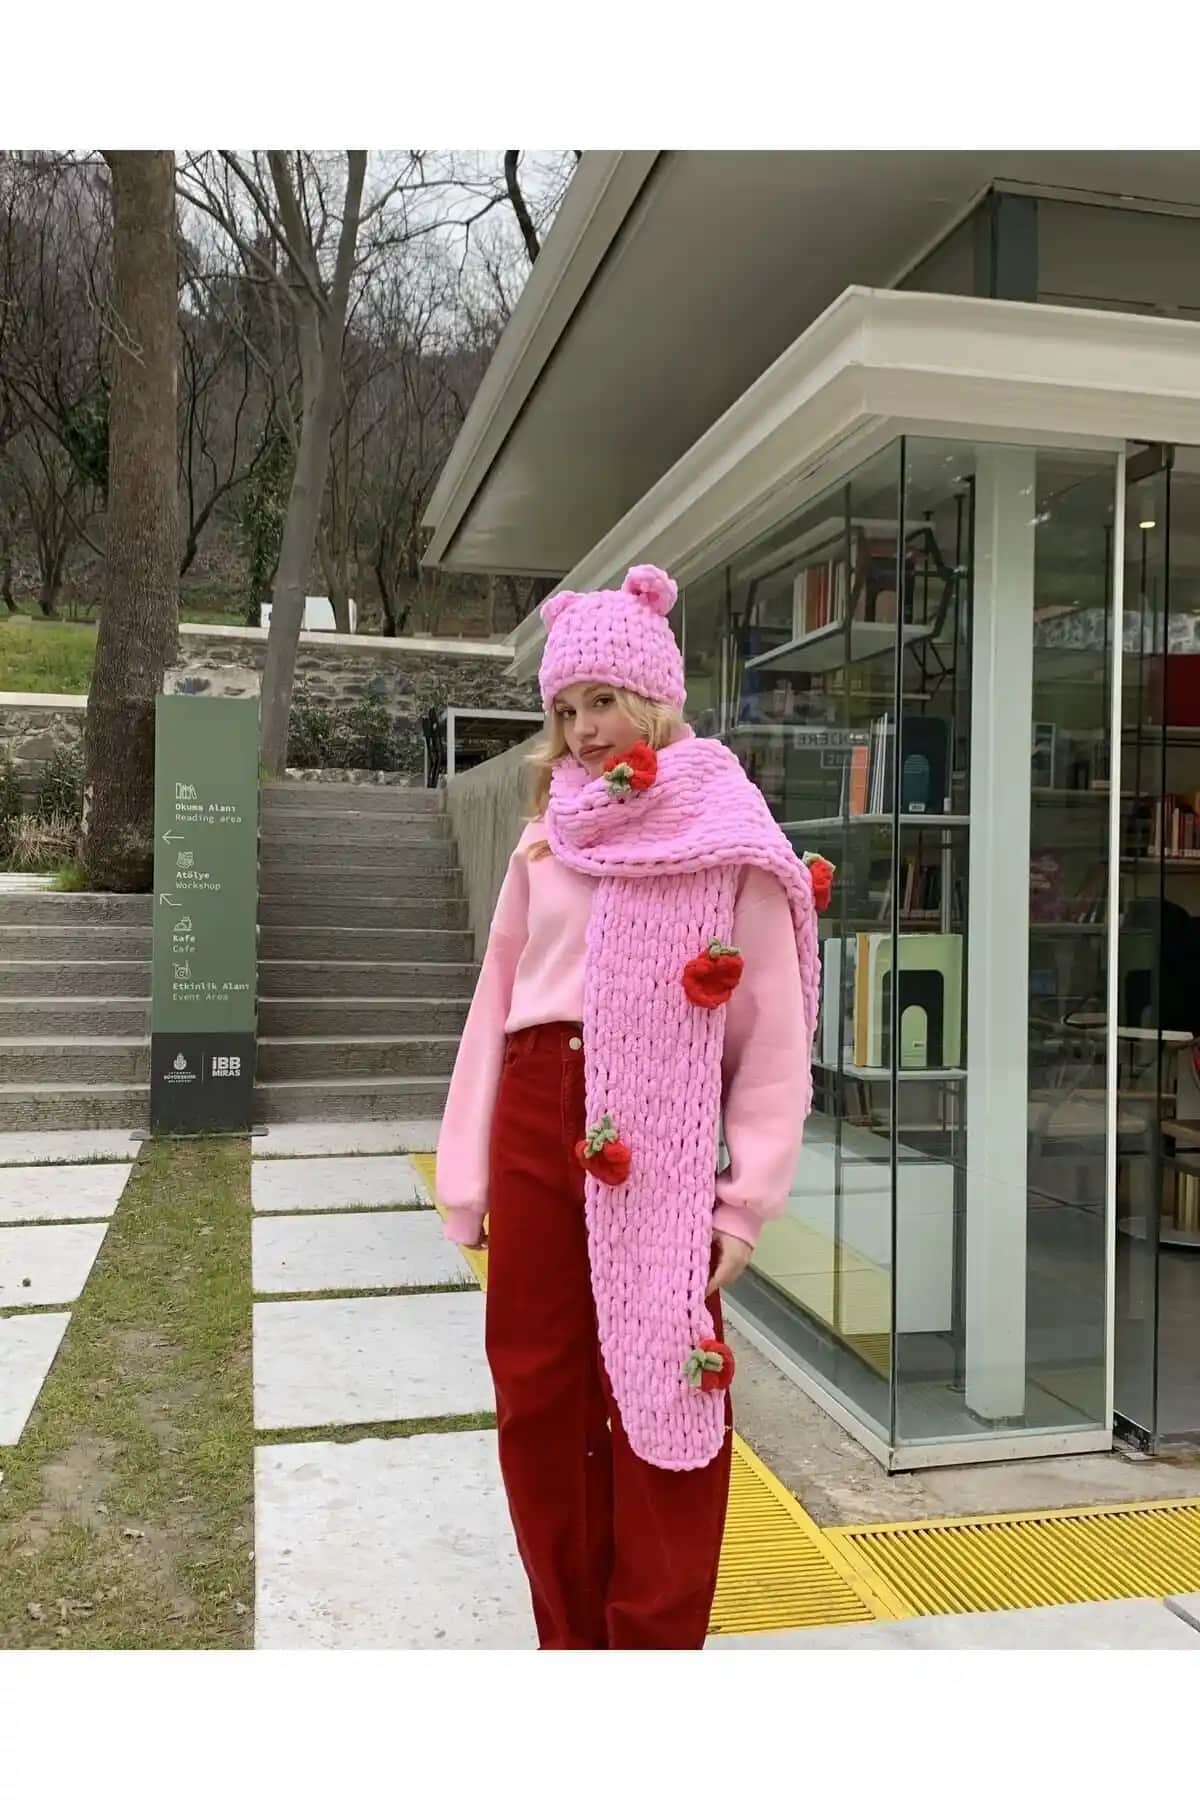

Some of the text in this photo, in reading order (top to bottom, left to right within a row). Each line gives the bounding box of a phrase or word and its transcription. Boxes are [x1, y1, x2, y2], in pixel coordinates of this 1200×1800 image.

[175, 802, 204, 811] Okuma
[175, 813, 242, 824] Reading area
[176, 870, 210, 880] Atölye
[175, 881, 221, 891] Workshop
[172, 934, 196, 943] Kafe
[172, 944, 196, 953] Cafe
[172, 982, 217, 990] Etkinlik
[172, 993, 229, 1001] Event Area
